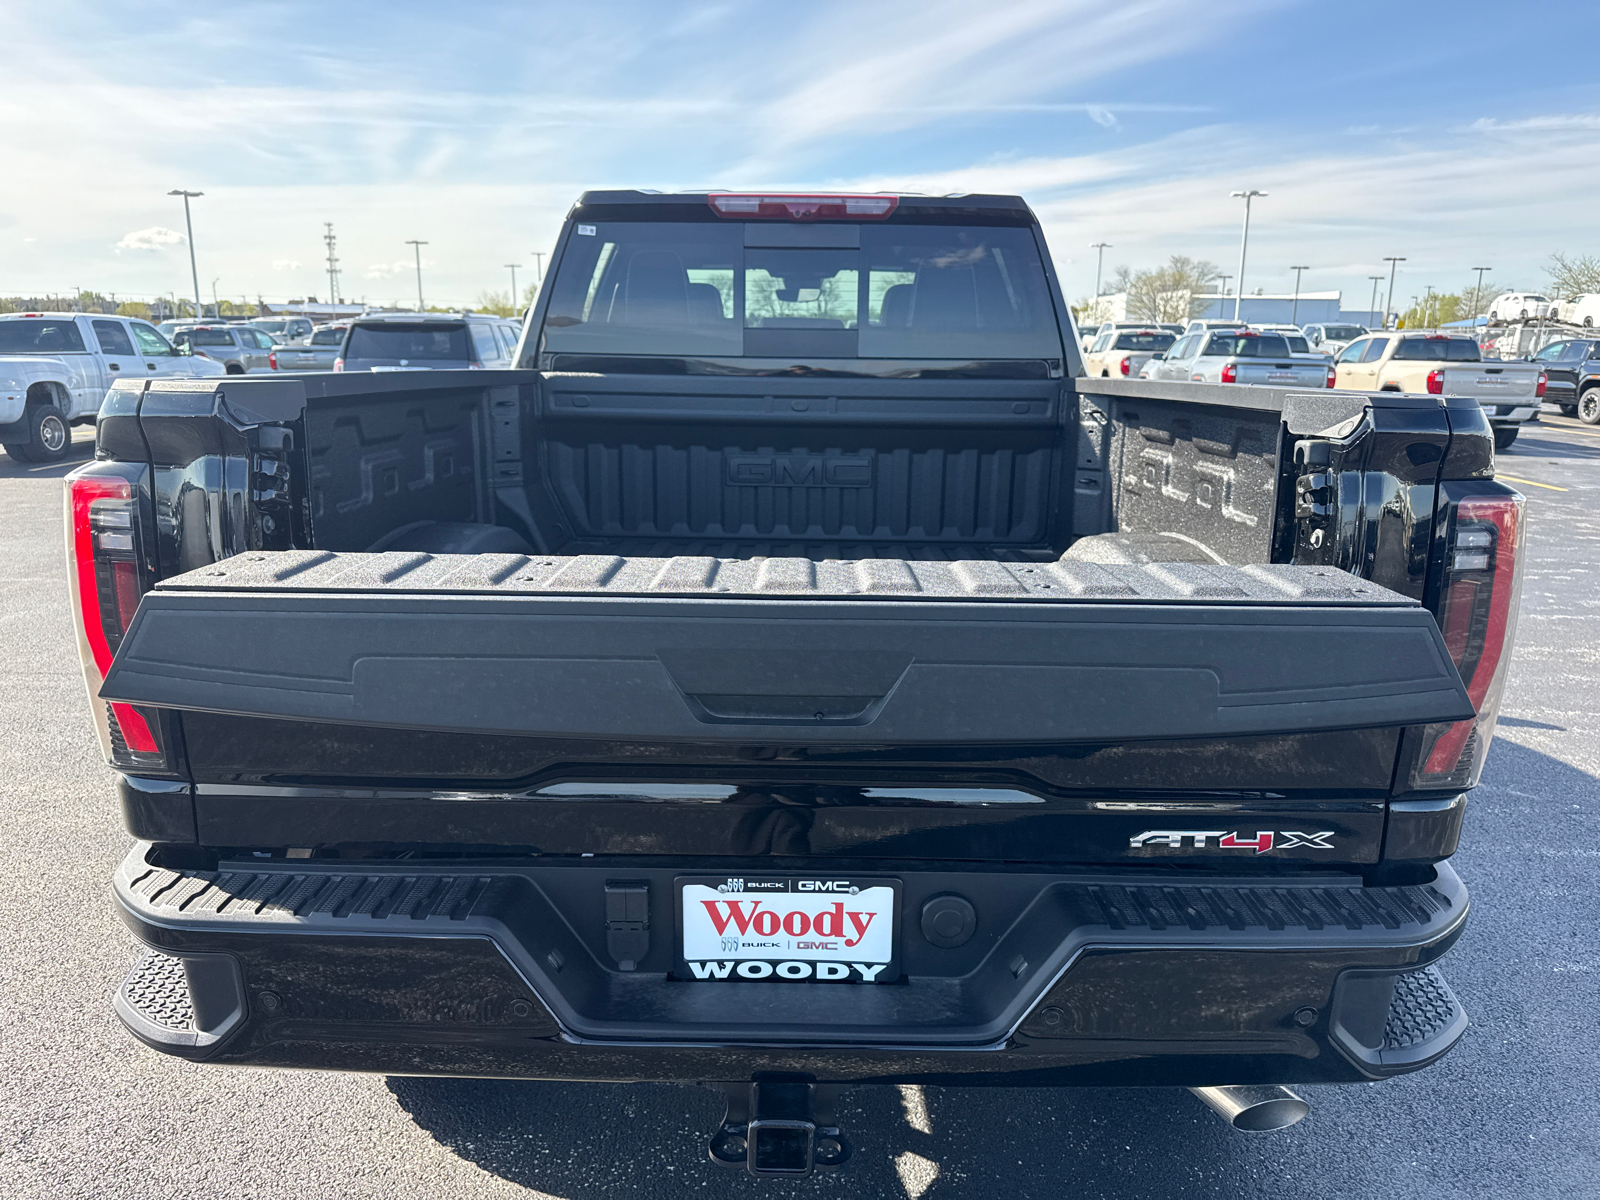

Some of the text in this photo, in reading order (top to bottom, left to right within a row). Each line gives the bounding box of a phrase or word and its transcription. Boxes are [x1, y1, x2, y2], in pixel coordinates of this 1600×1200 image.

[729, 458, 870, 485] GMC
[1130, 830, 1335, 855] AT4X
[798, 880, 850, 891] GMC
[700, 900, 878, 947] Woody
[796, 941, 838, 950] GMC
[688, 961, 887, 982] WOODY
